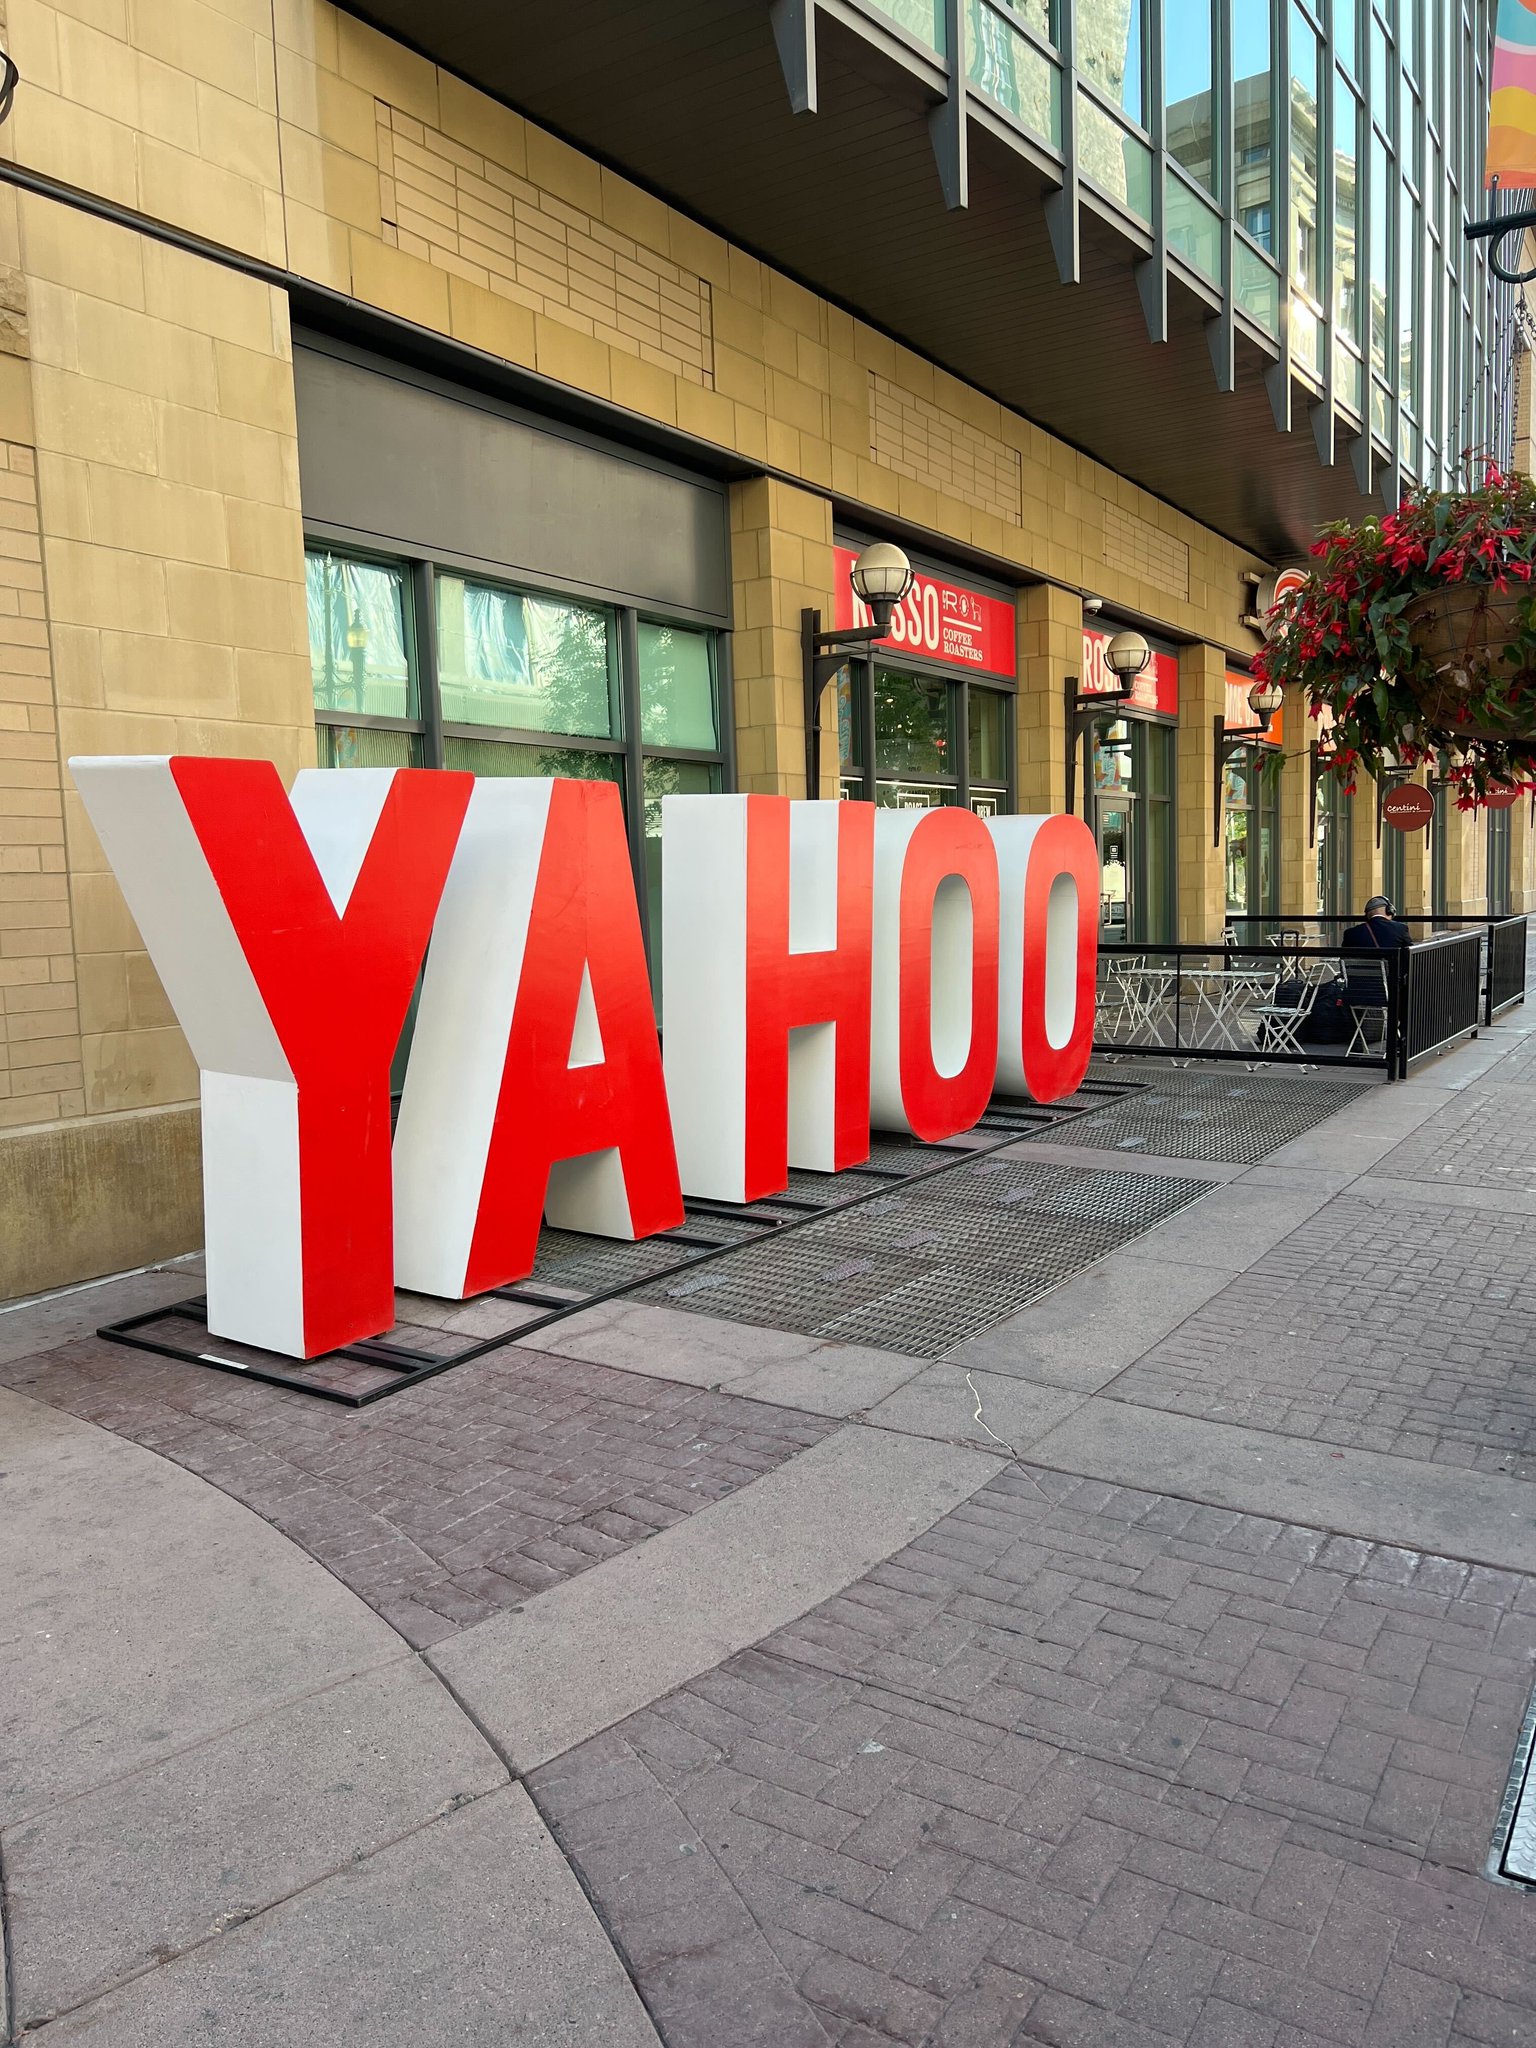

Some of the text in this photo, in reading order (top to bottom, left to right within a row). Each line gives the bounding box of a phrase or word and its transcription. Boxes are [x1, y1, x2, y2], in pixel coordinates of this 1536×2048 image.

[943, 627, 972, 646] COFFEE
[943, 641, 983, 661] ROASTERS
[1387, 802, 1421, 812] centini
[169, 755, 1099, 1360] YAHOO
